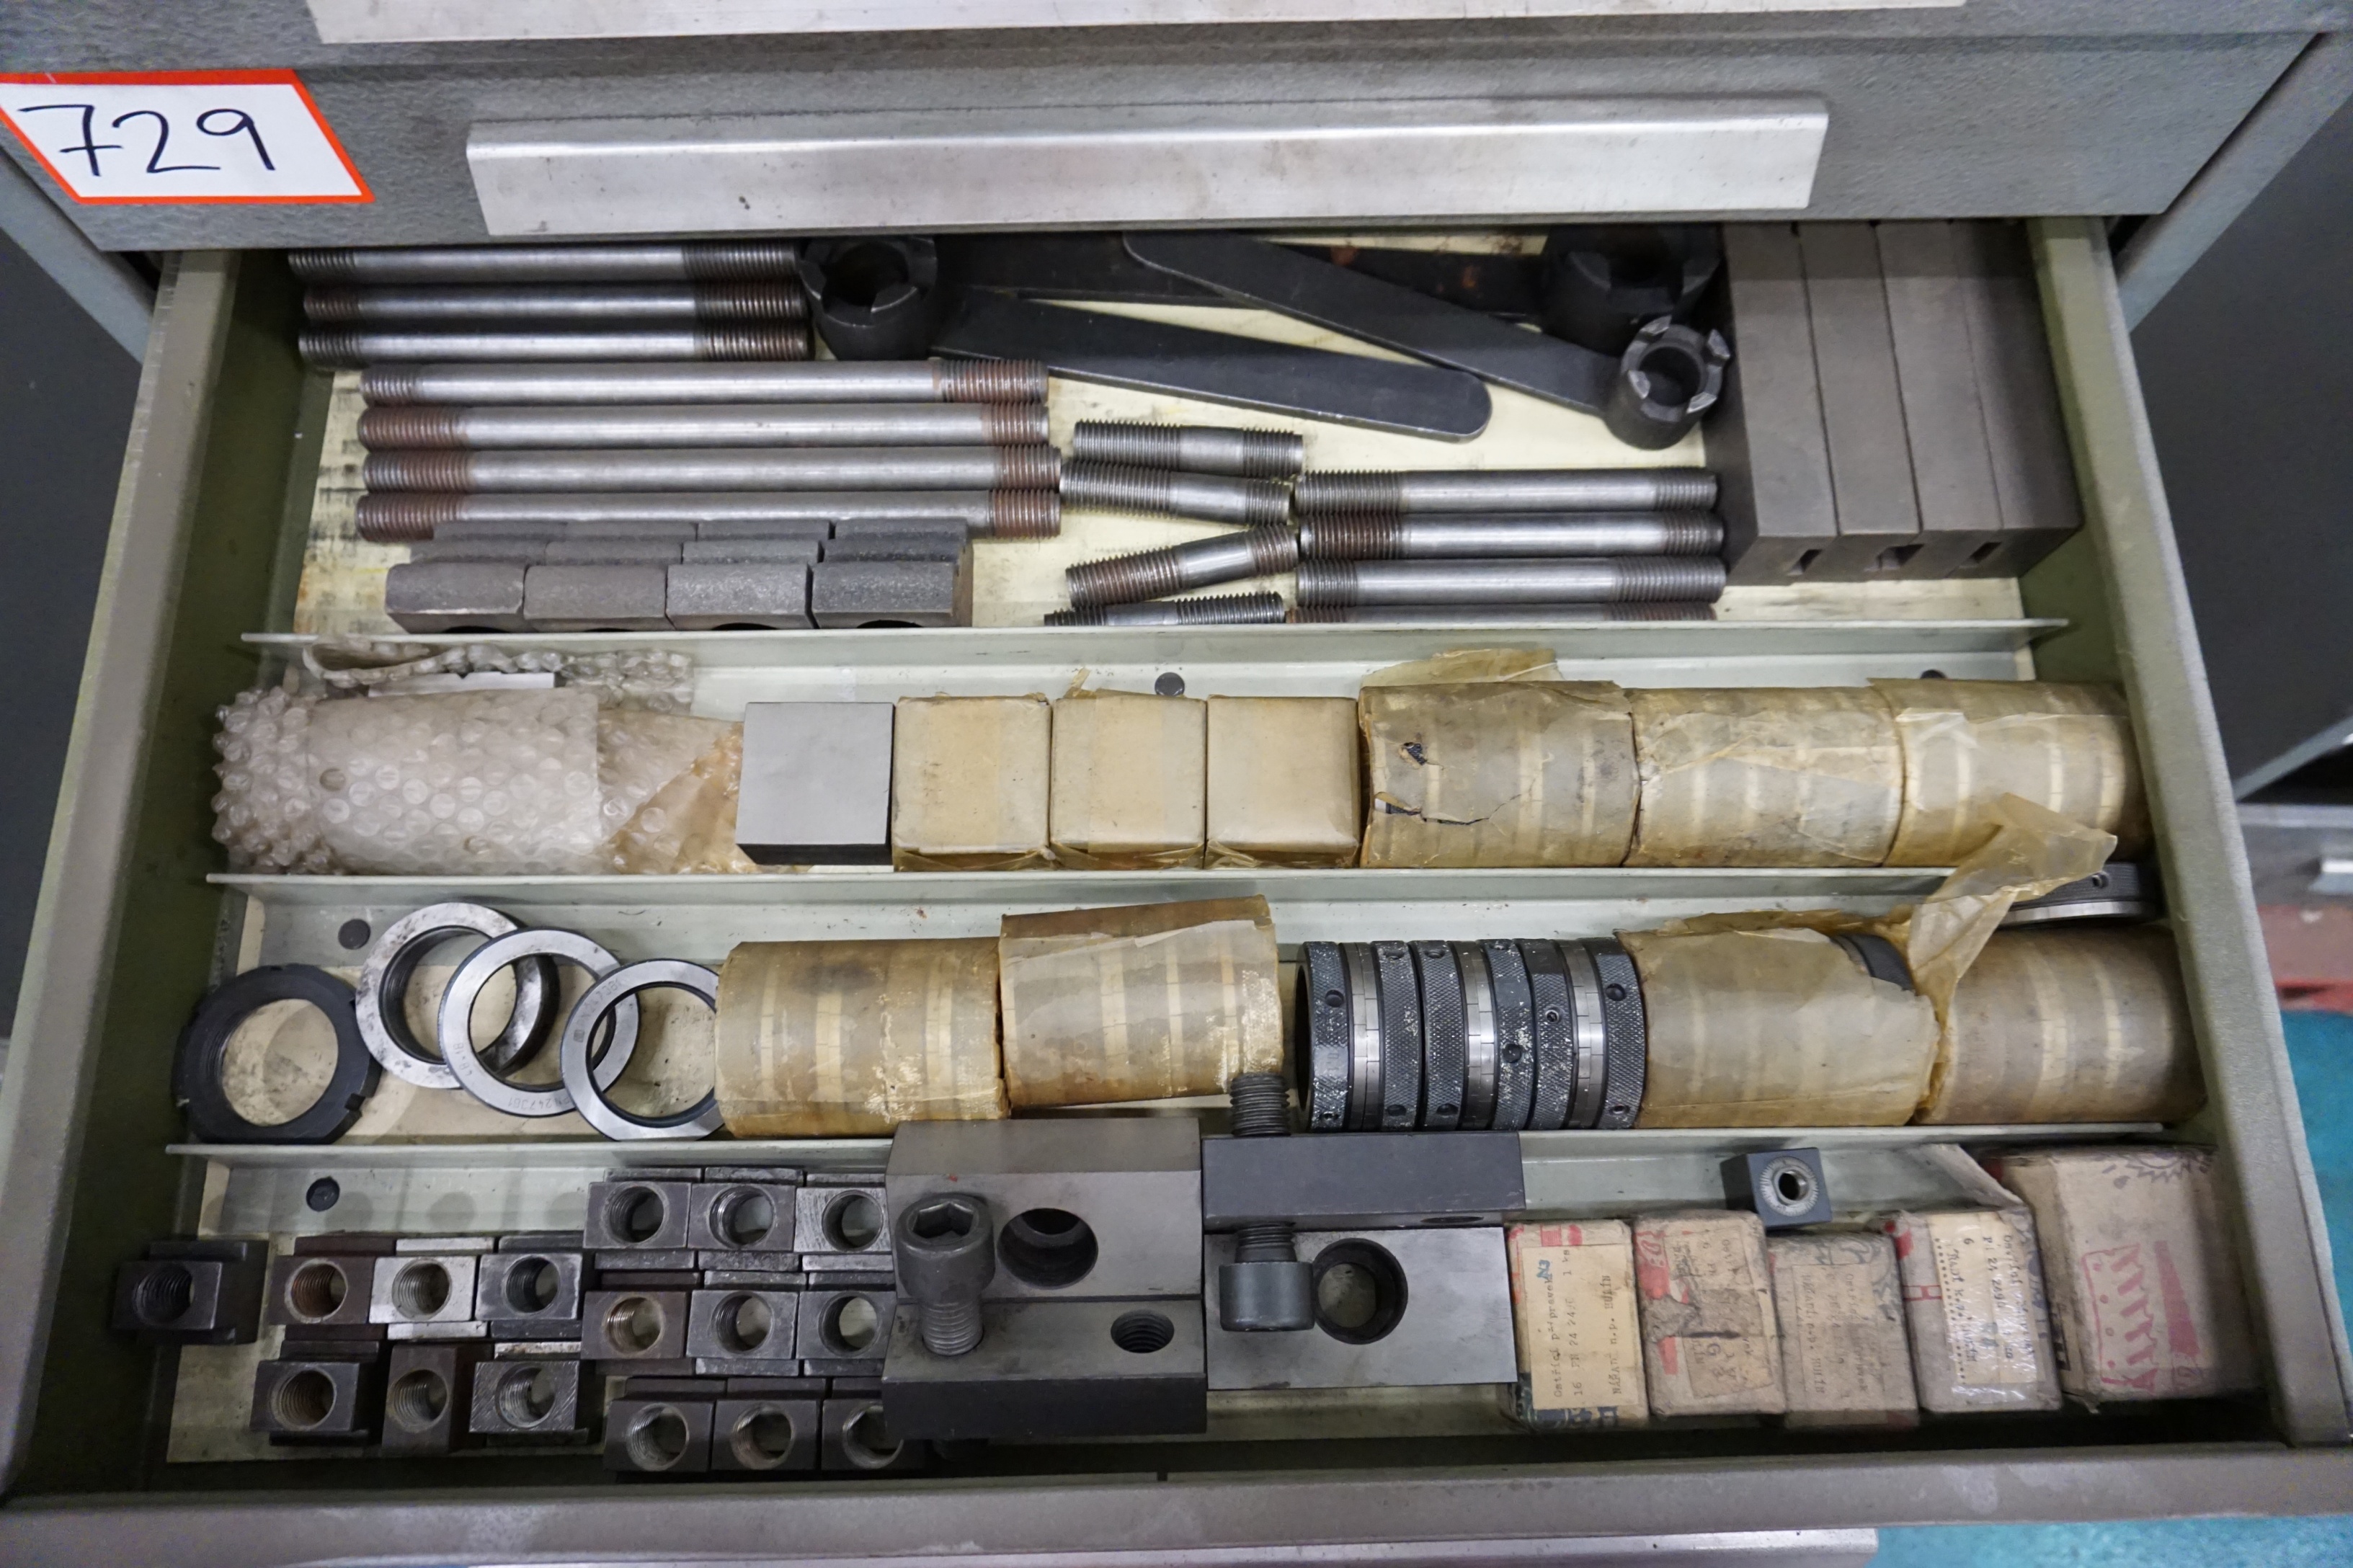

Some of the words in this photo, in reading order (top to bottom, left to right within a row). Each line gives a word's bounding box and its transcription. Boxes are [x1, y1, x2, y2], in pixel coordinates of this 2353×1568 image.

[17, 104, 275, 176] 729
[1568, 1333, 1578, 1346] 24
[1609, 1318, 1617, 1345] n.p.
[1573, 1382, 1583, 1396] 16
